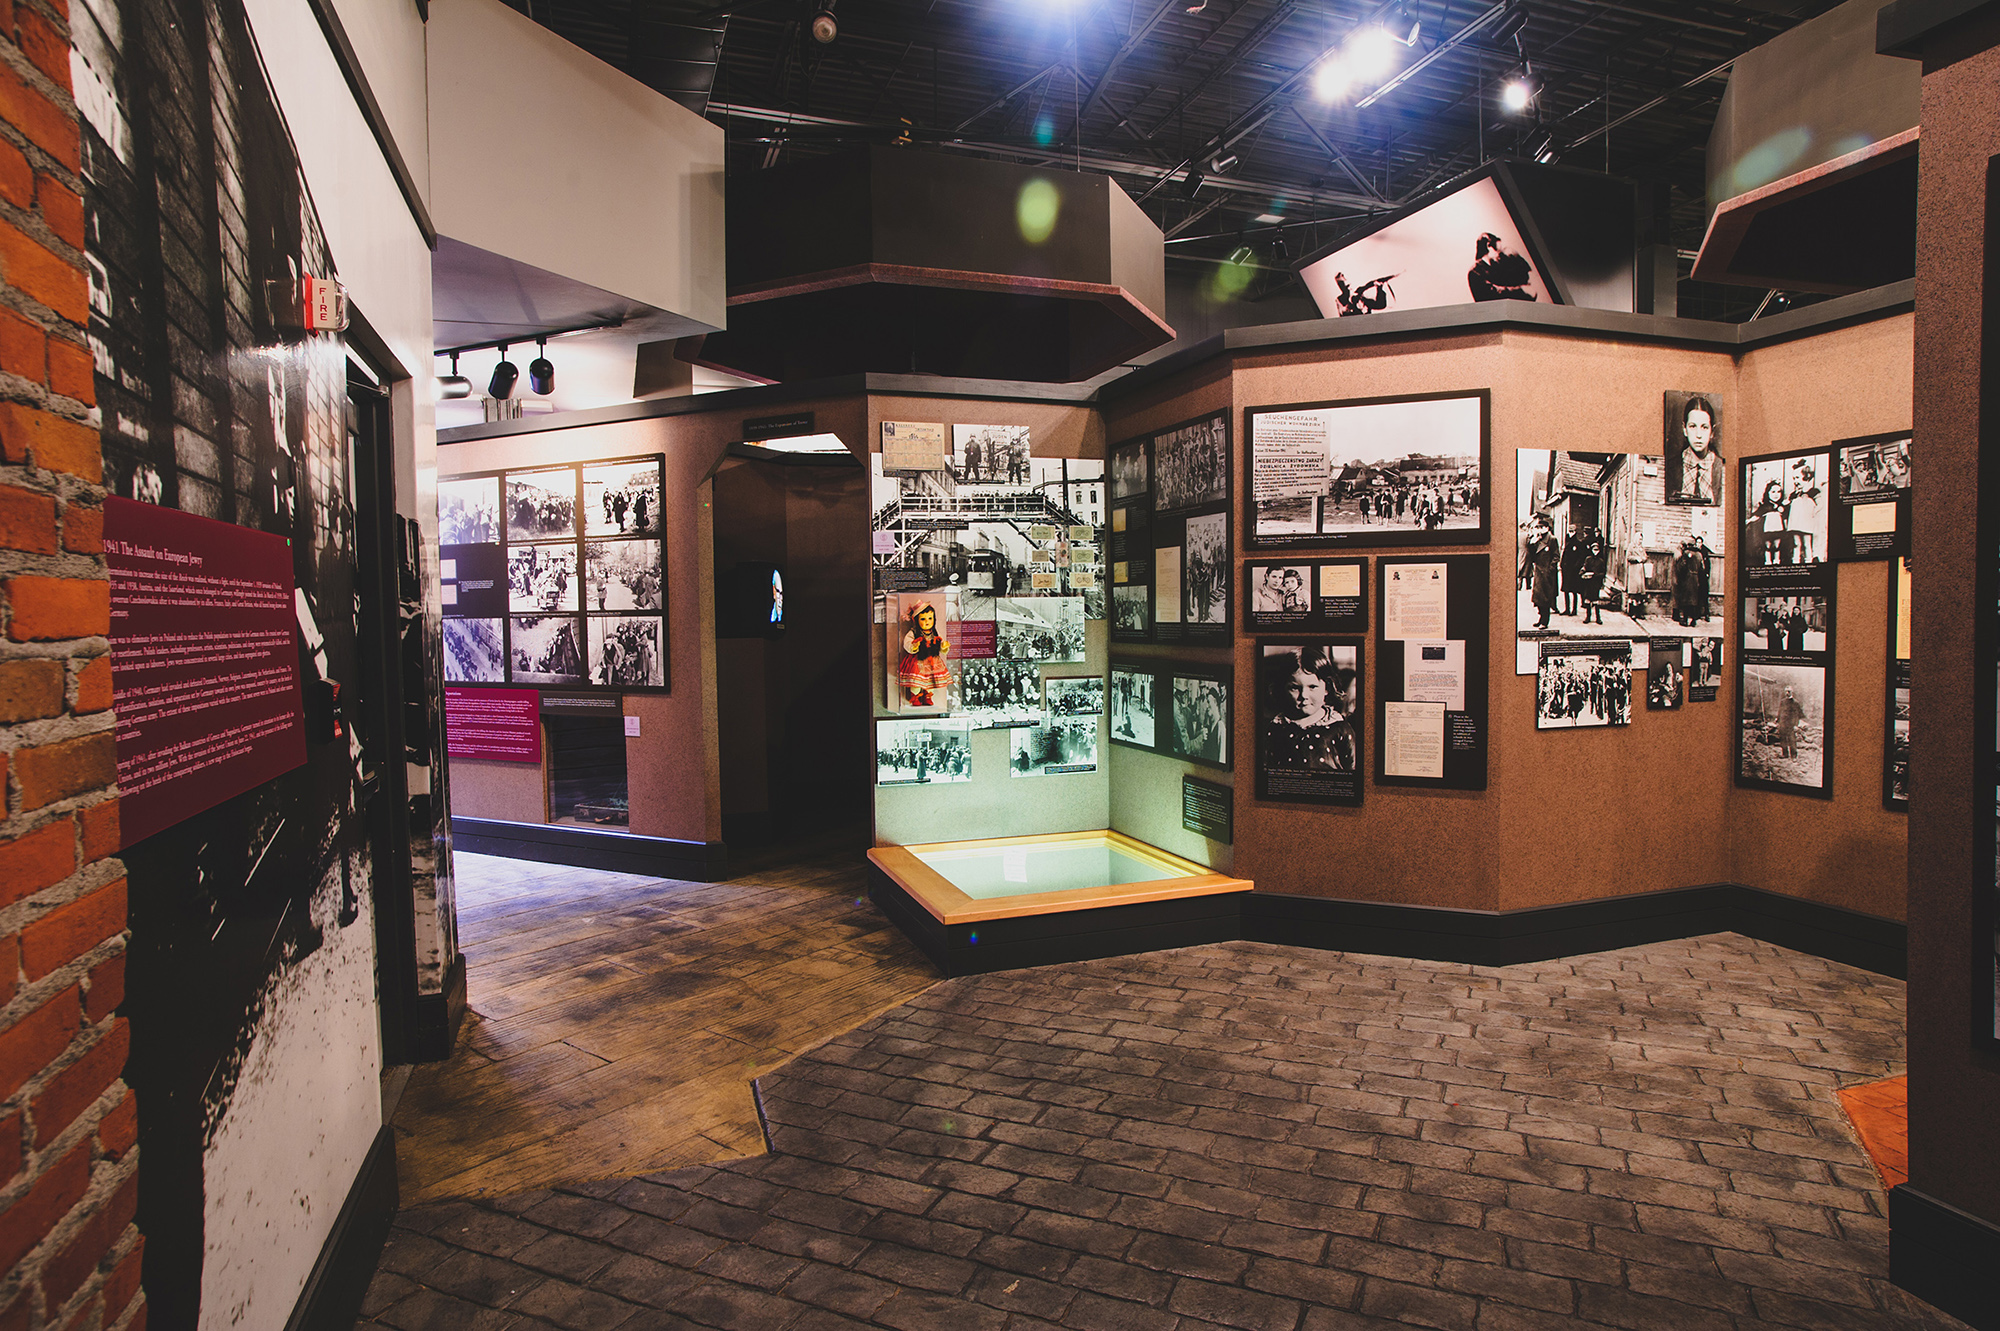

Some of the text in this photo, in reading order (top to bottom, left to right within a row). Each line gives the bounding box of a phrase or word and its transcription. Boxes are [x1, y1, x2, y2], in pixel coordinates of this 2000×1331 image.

[319, 288, 328, 320] FIRE
[1264, 414, 1318, 422] SEUCHENGEFAHR
[103, 539, 203, 567] 1941 The Assault on European Jewry
